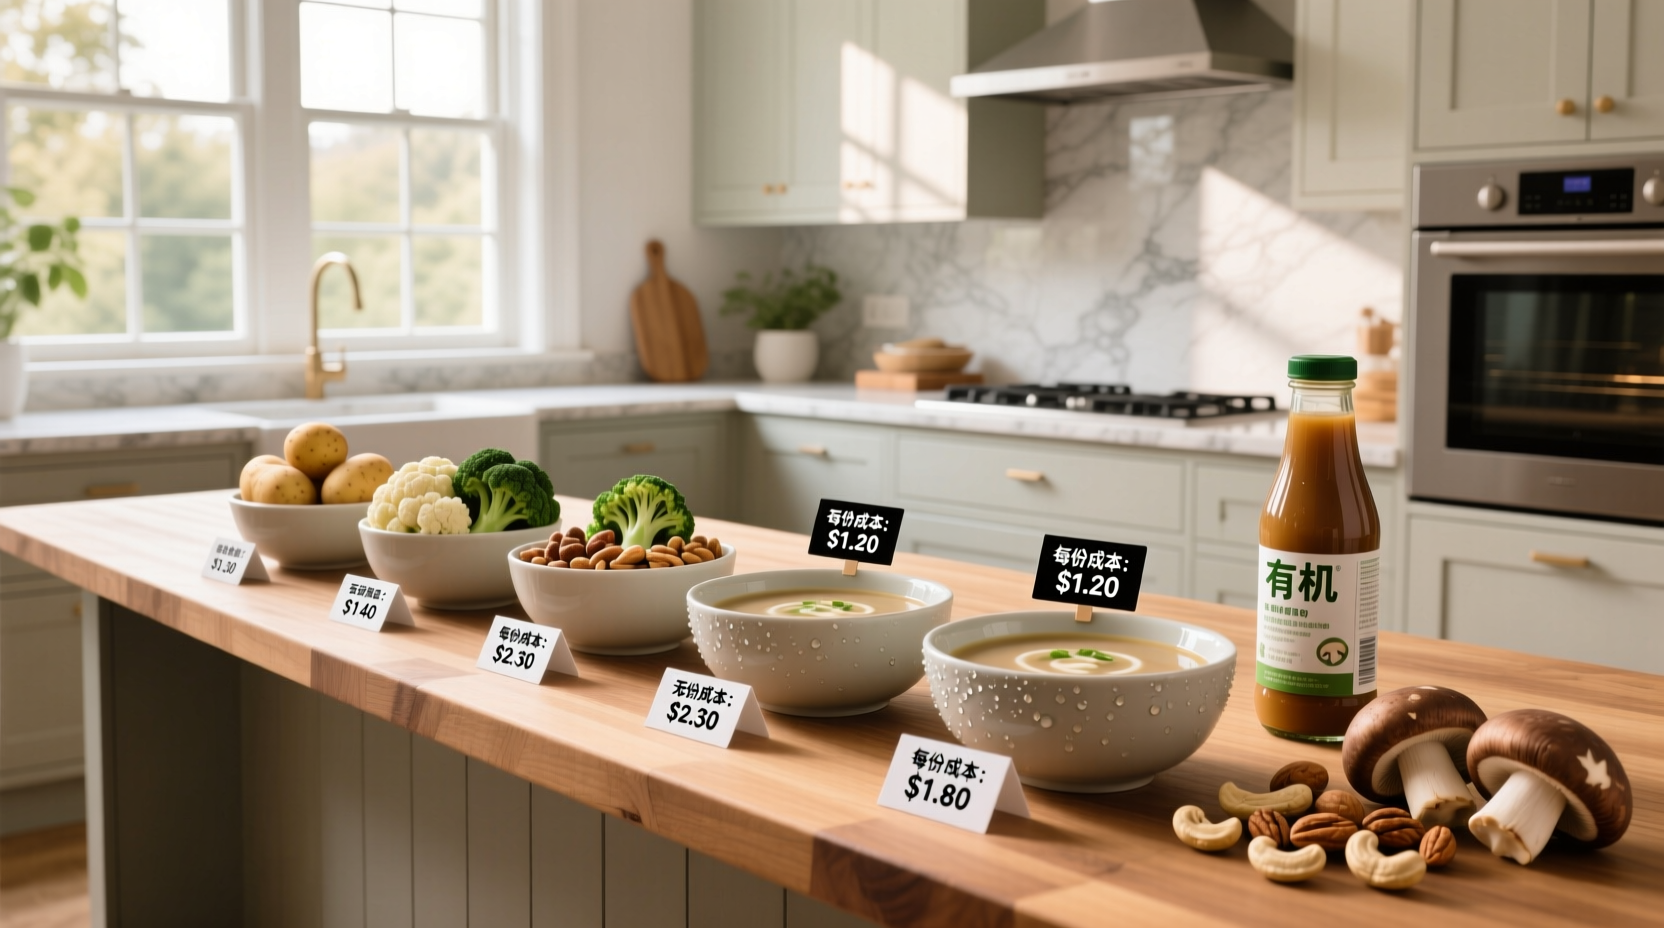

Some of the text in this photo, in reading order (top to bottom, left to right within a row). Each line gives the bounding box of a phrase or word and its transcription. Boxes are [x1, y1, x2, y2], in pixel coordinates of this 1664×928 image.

[827, 528, 880, 554] $1.20
[1055, 569, 1120, 598] $1.20
[1265, 558, 1339, 603] 有机
[492, 644, 536, 670] $2.30
[666, 701, 720, 731] $2.30
[904, 772, 971, 811] $1.80
